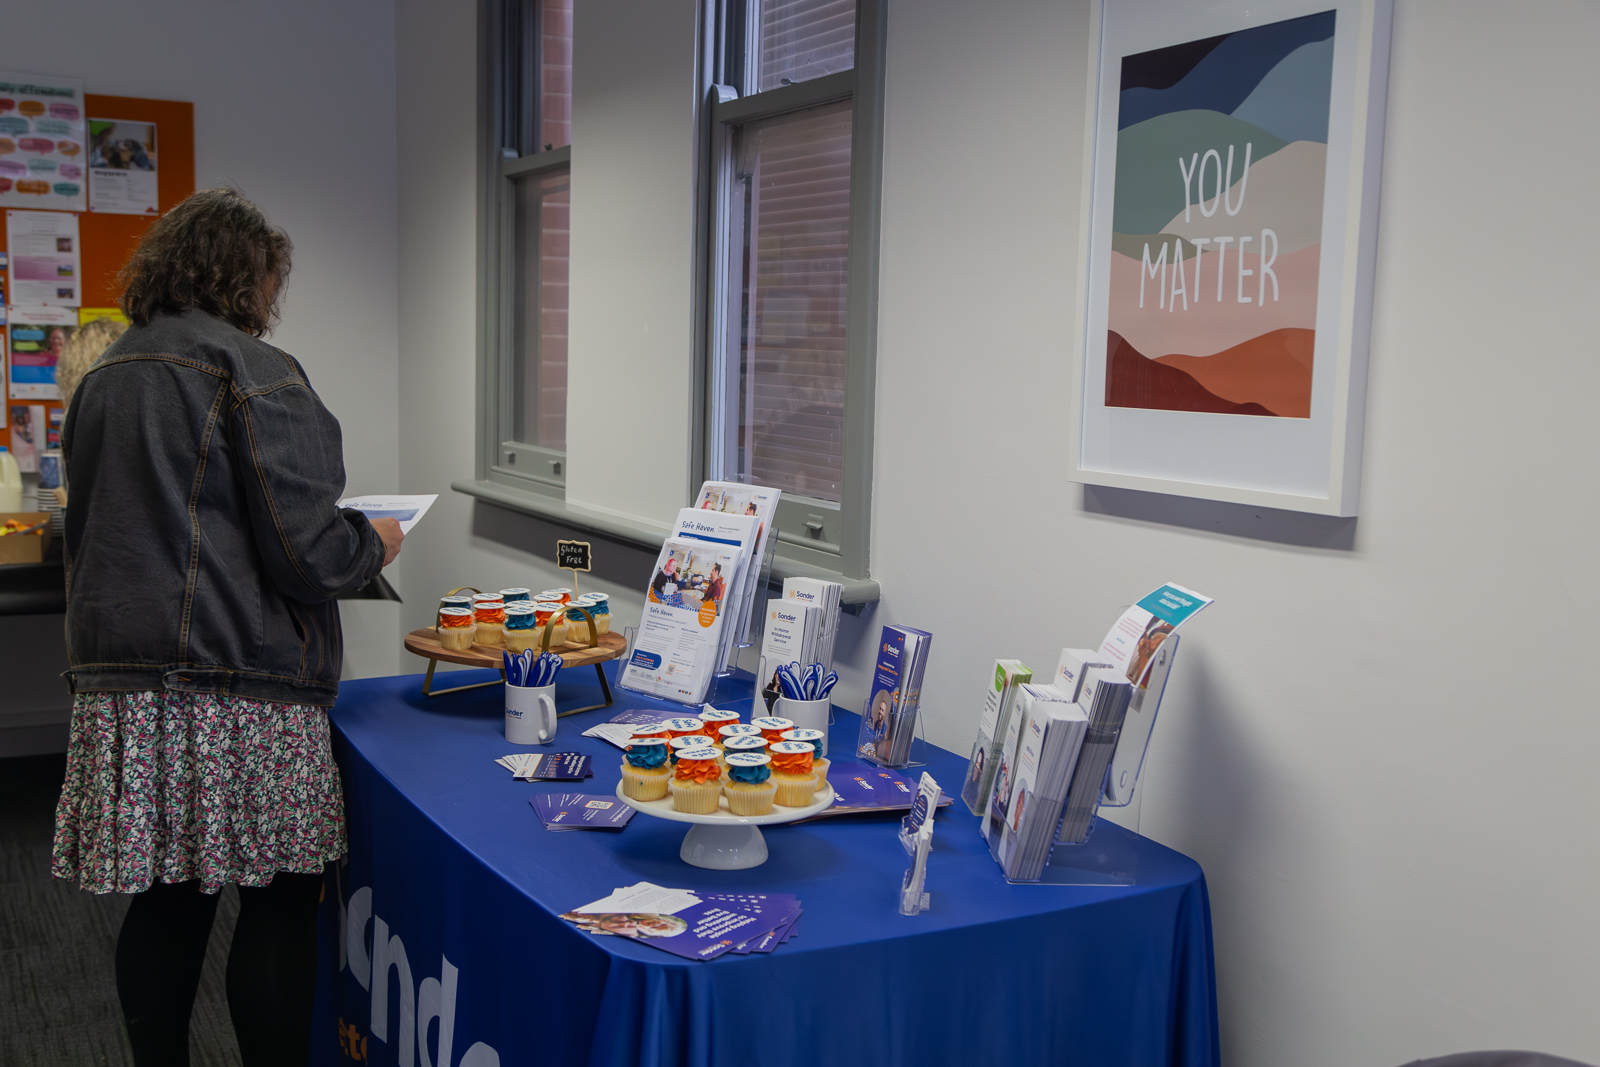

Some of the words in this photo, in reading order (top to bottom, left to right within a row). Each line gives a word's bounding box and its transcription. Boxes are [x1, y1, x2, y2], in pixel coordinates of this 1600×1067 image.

[1179, 142, 1252, 223] YOU
[1139, 228, 1279, 312] MATTER
[681, 520, 695, 530] Safe
[560, 545, 583, 556] Gluten
[566, 555, 582, 564] Free
[796, 590, 815, 600] Sonder
[777, 612, 797, 621] Sonder
[888, 644, 900, 655] Sonder
